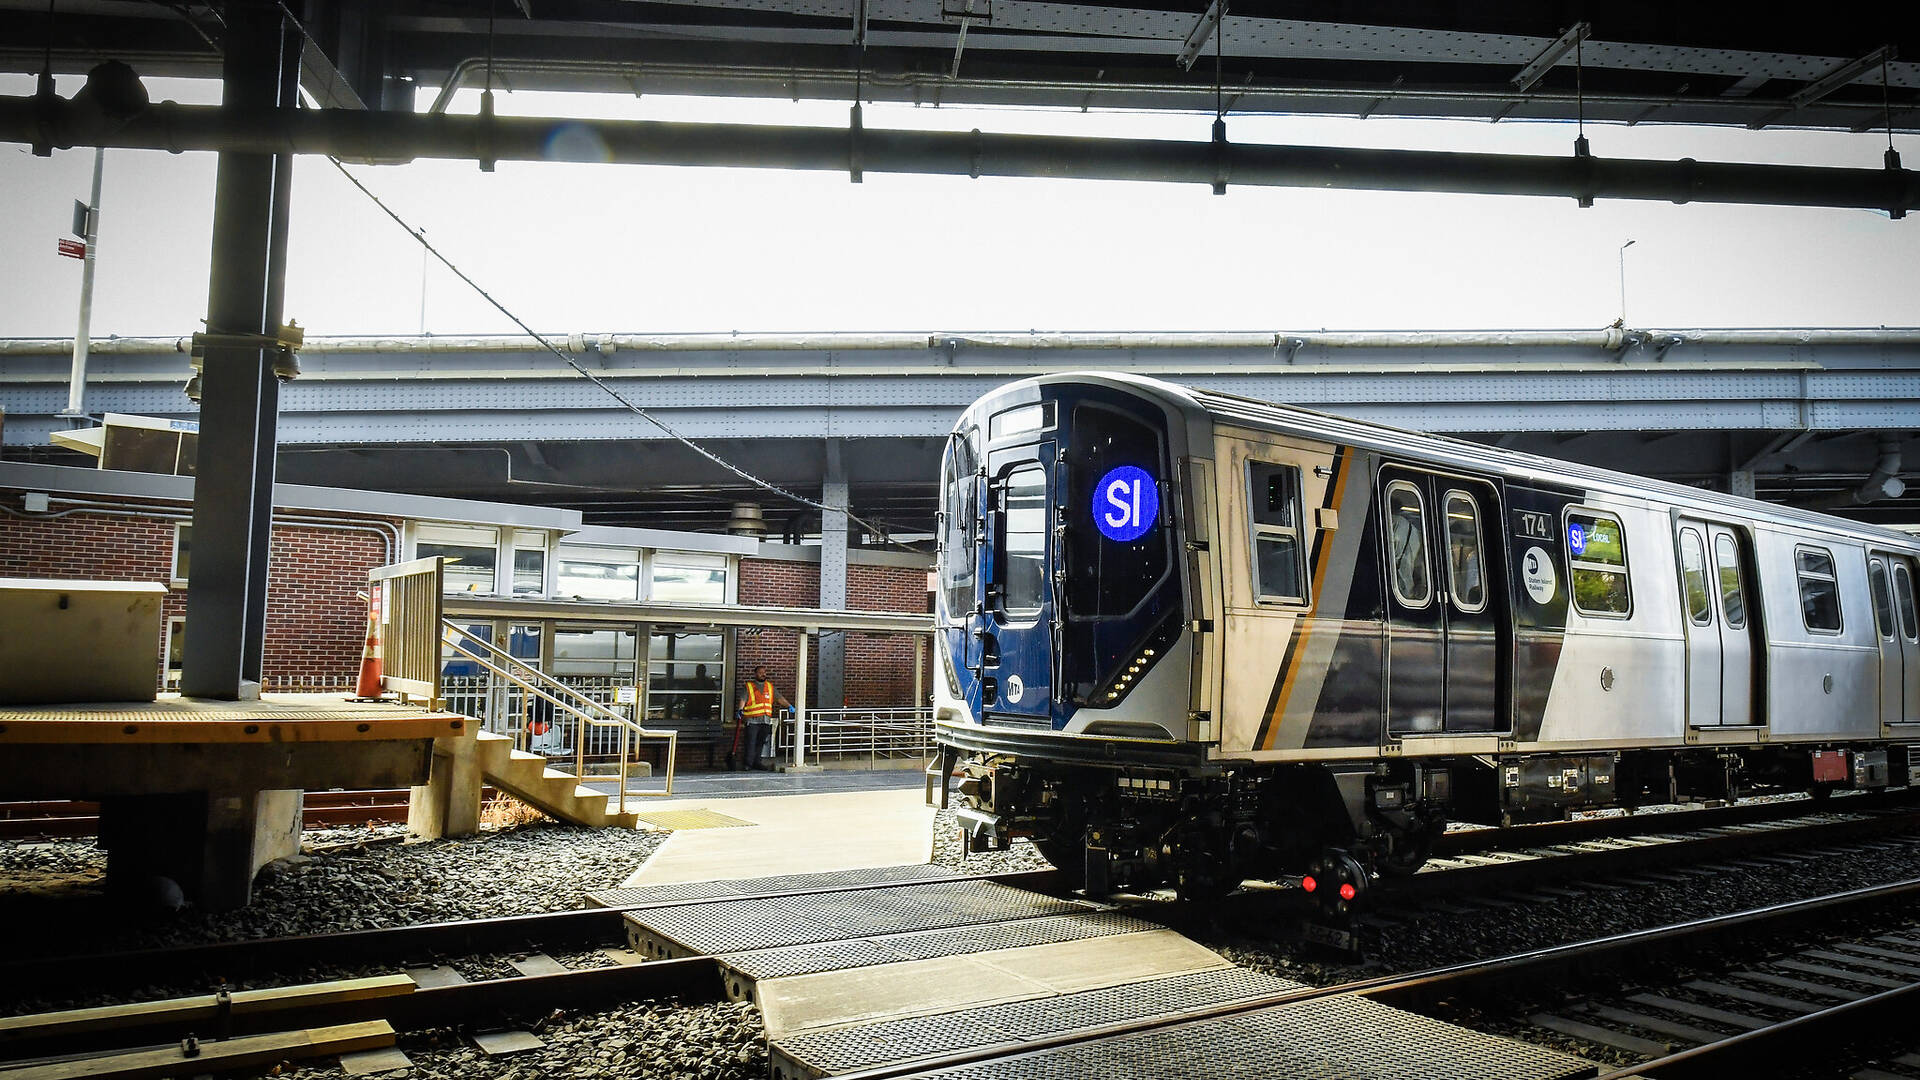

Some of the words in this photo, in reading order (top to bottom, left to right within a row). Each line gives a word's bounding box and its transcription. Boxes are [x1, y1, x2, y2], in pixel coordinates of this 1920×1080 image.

[1104, 479, 1141, 528] SI
[1522, 513, 1546, 537] 174
[1571, 529, 1583, 549] SI
[1528, 576, 1541, 584] Staten
[1528, 584, 1544, 592] Railway
[1007, 680, 1020, 697] MTA
